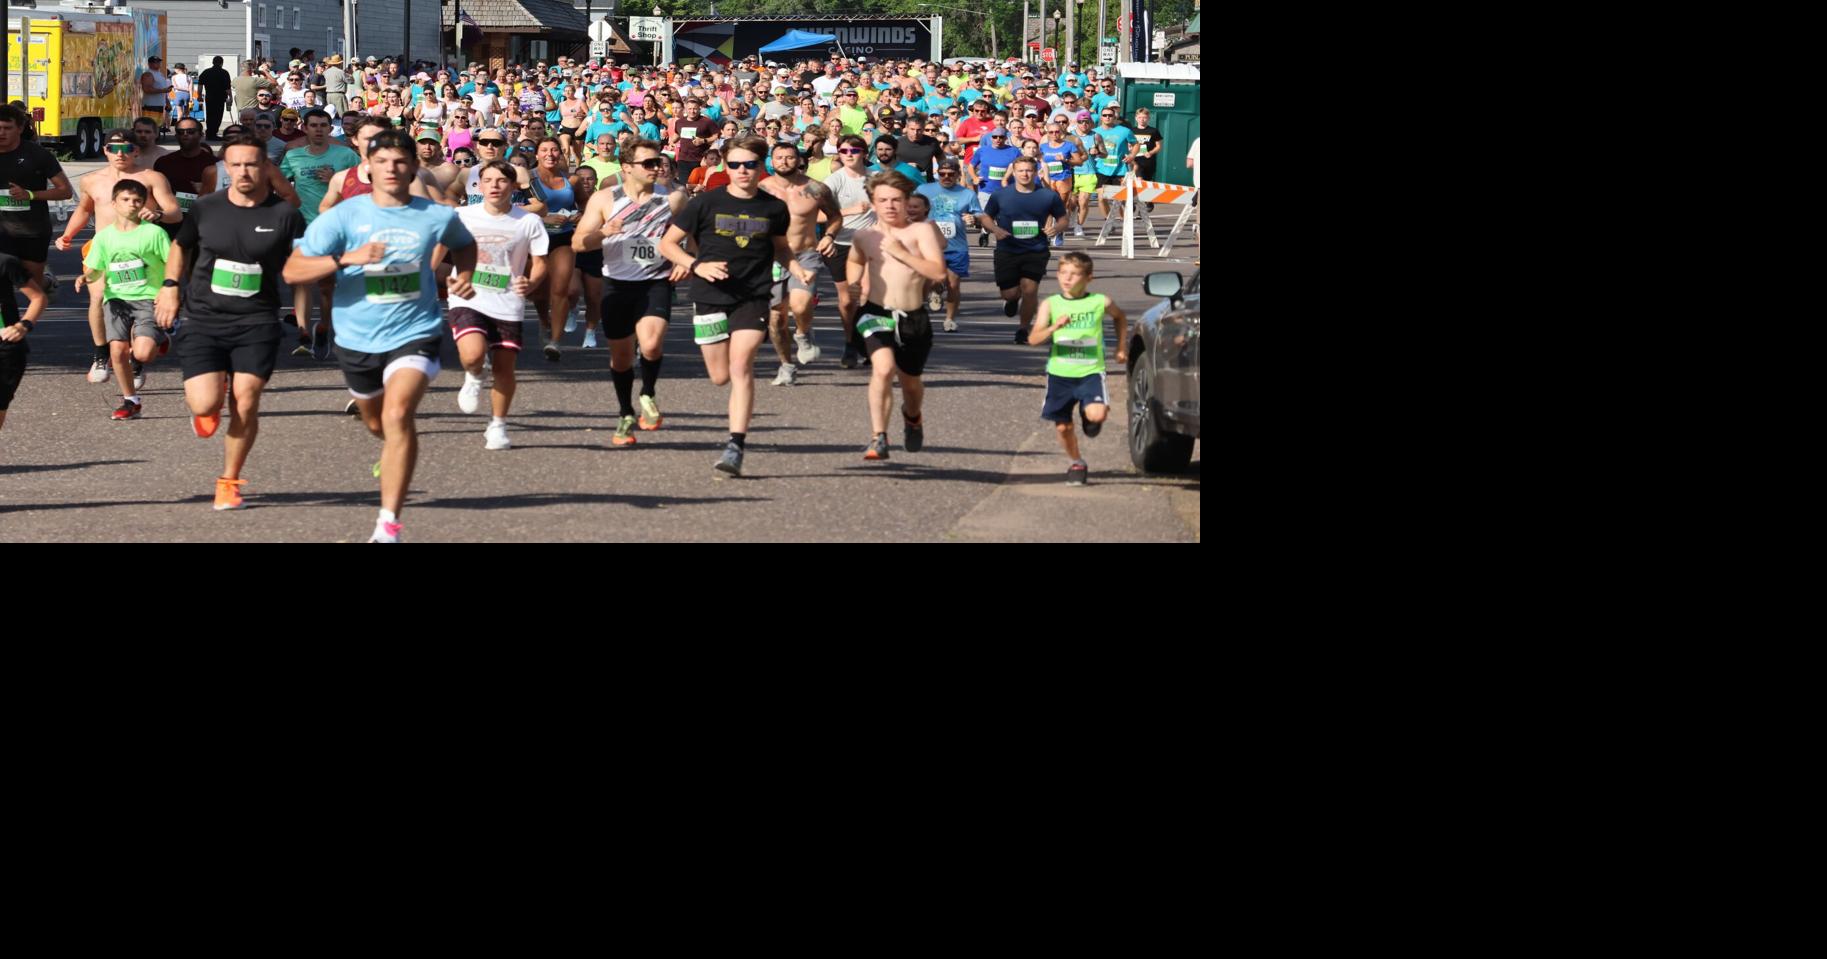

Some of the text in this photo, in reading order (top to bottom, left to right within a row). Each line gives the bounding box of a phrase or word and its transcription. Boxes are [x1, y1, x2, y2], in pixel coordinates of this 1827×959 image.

[637, 31, 657, 39] Shop
[630, 245, 655, 260] 708
[117, 269, 139, 283] 141
[232, 273, 241, 289] 9
[480, 272, 501, 287] 143
[377, 275, 409, 296] 142
[1070, 311, 1096, 321] EGIT
